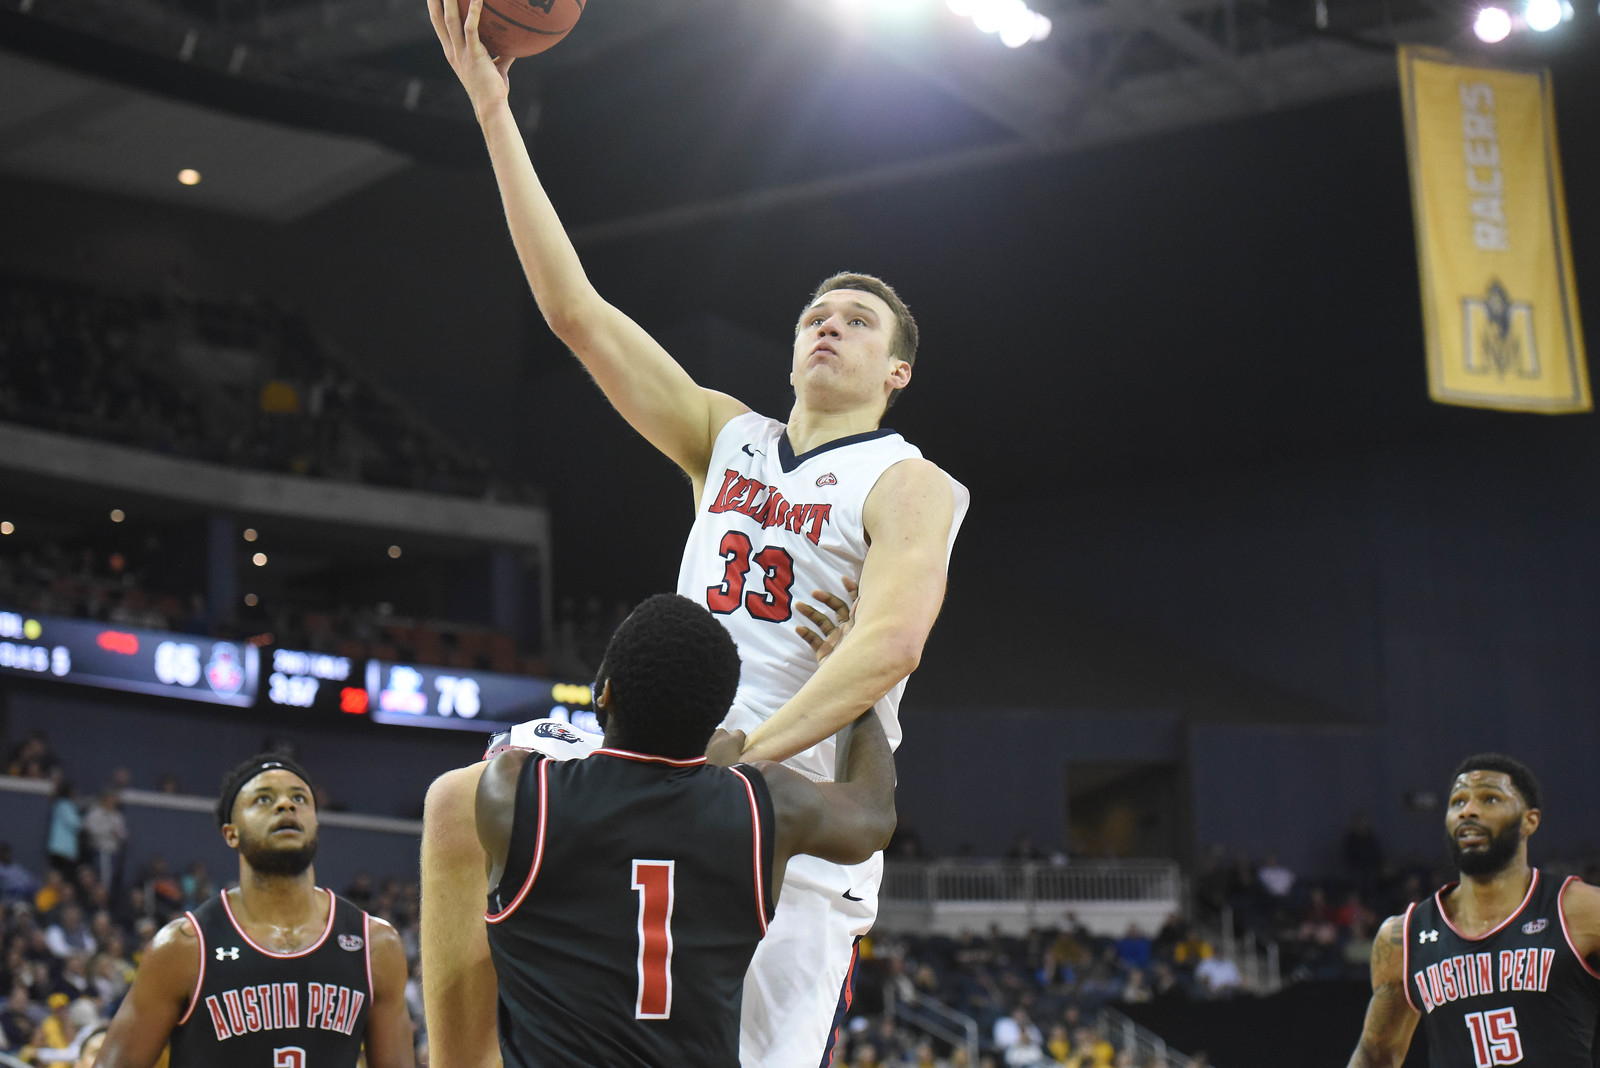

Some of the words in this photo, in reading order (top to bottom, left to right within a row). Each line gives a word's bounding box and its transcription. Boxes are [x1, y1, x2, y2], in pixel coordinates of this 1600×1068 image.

[1459, 81, 1510, 251] RACERS
[706, 530, 795, 623] 33
[434, 675, 480, 718] 76
[631, 859, 675, 1019] 1
[205, 983, 300, 1041] AUSTIN
[307, 982, 365, 1036] PEAY
[1414, 952, 1494, 1014] AUSTIN
[1499, 948, 1555, 992] PEAY
[1464, 1007, 1523, 1068] 15
